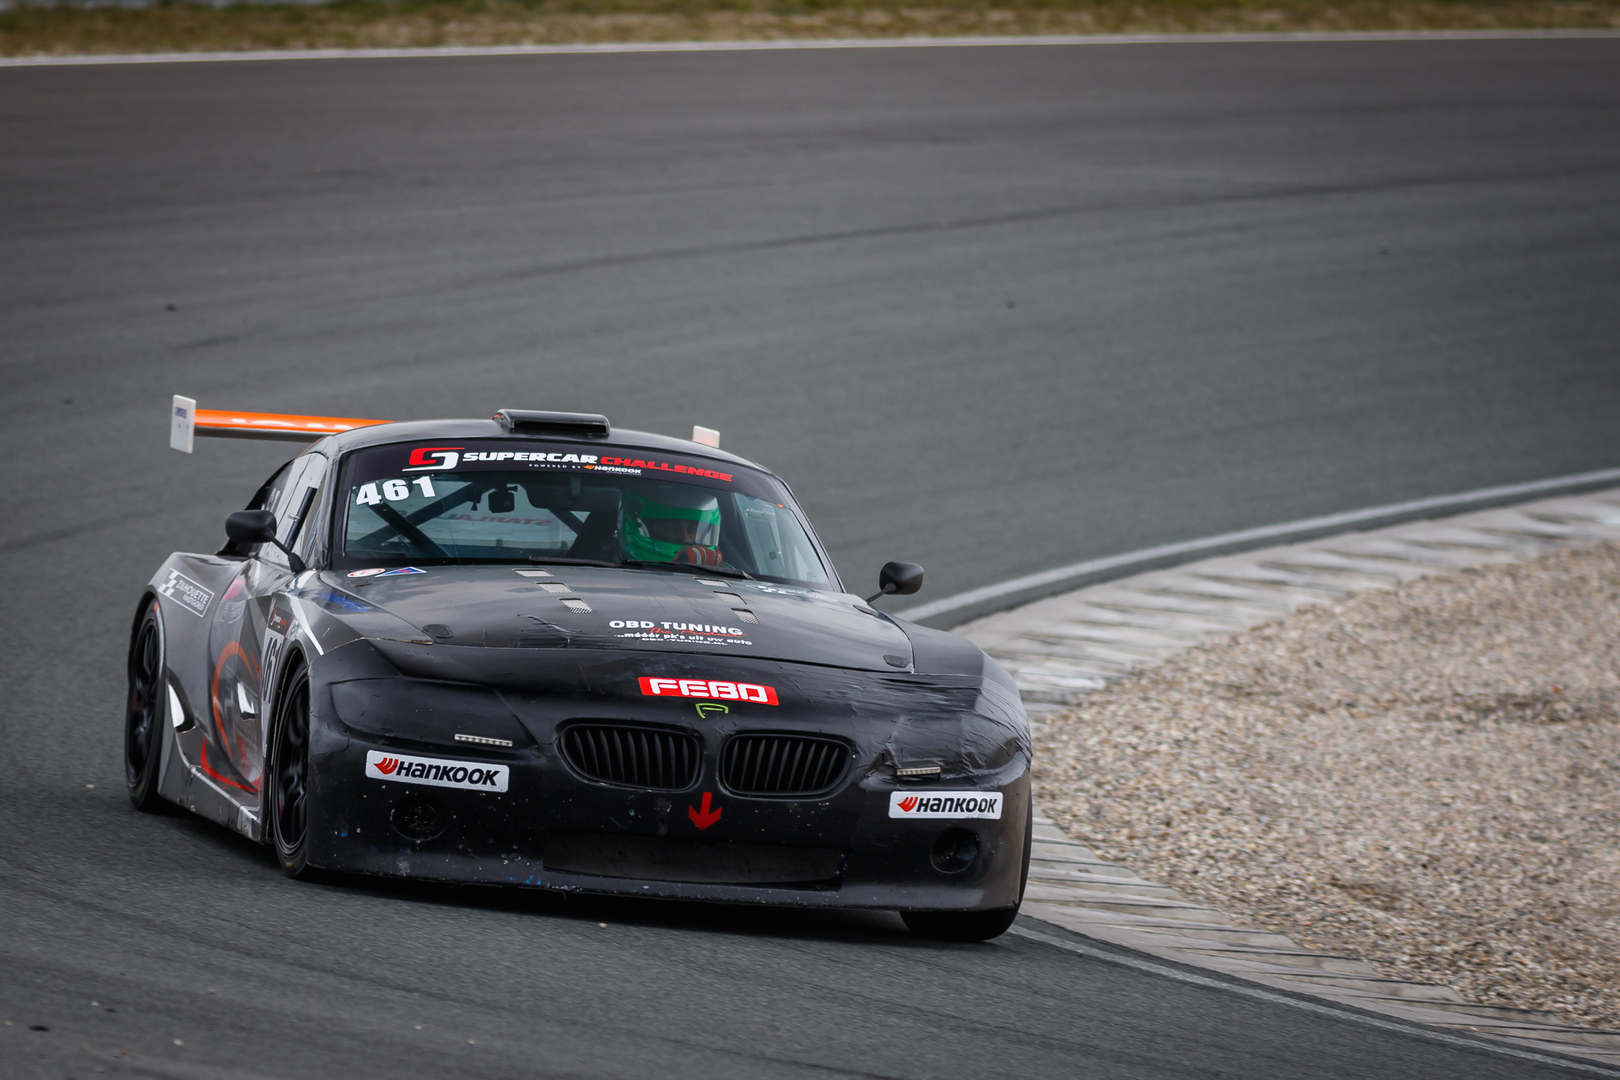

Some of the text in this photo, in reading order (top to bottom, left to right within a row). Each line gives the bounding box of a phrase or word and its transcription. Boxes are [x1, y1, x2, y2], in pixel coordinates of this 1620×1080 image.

[462, 452, 733, 482] SUPERCAR CHALLENGE
[356, 476, 436, 506] 461
[176, 579, 210, 605] ZILHOUETTE
[609, 620, 743, 636] OBD TUNING
[649, 678, 768, 703] FEBO
